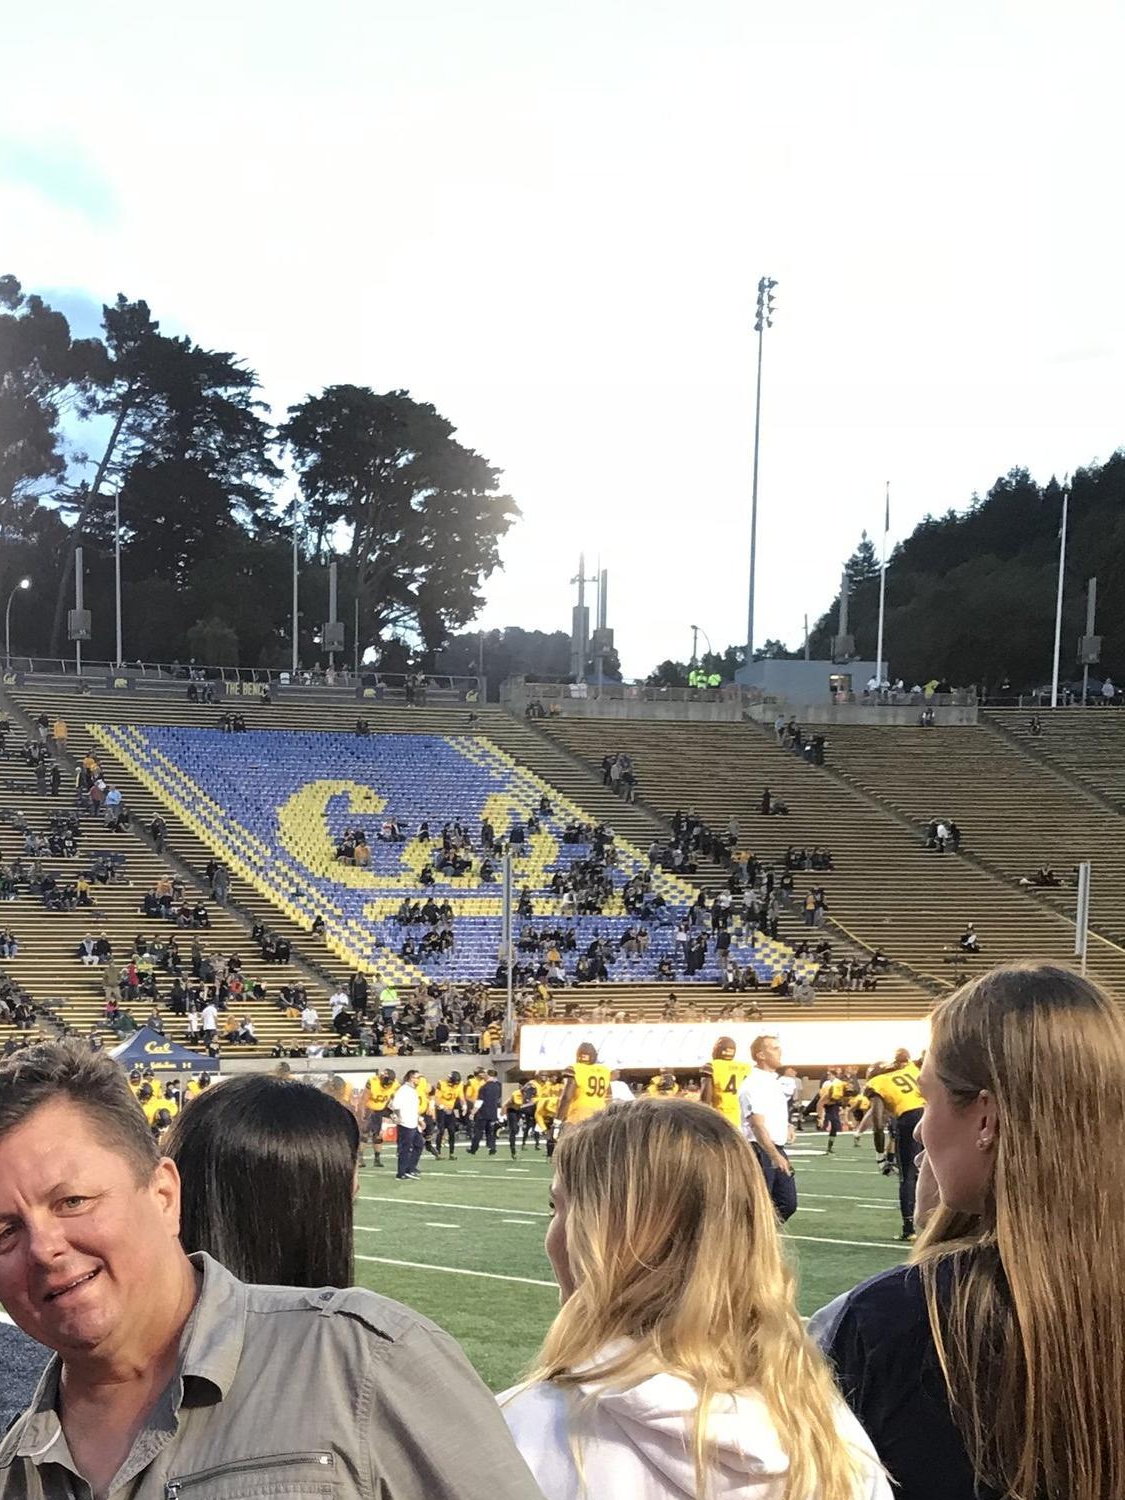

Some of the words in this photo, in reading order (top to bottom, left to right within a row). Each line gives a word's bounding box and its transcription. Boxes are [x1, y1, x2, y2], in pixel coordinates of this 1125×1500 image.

[225, 681, 240, 696] THE
[144, 1041, 174, 1055] Cal
[586, 1075, 606, 1097] 98
